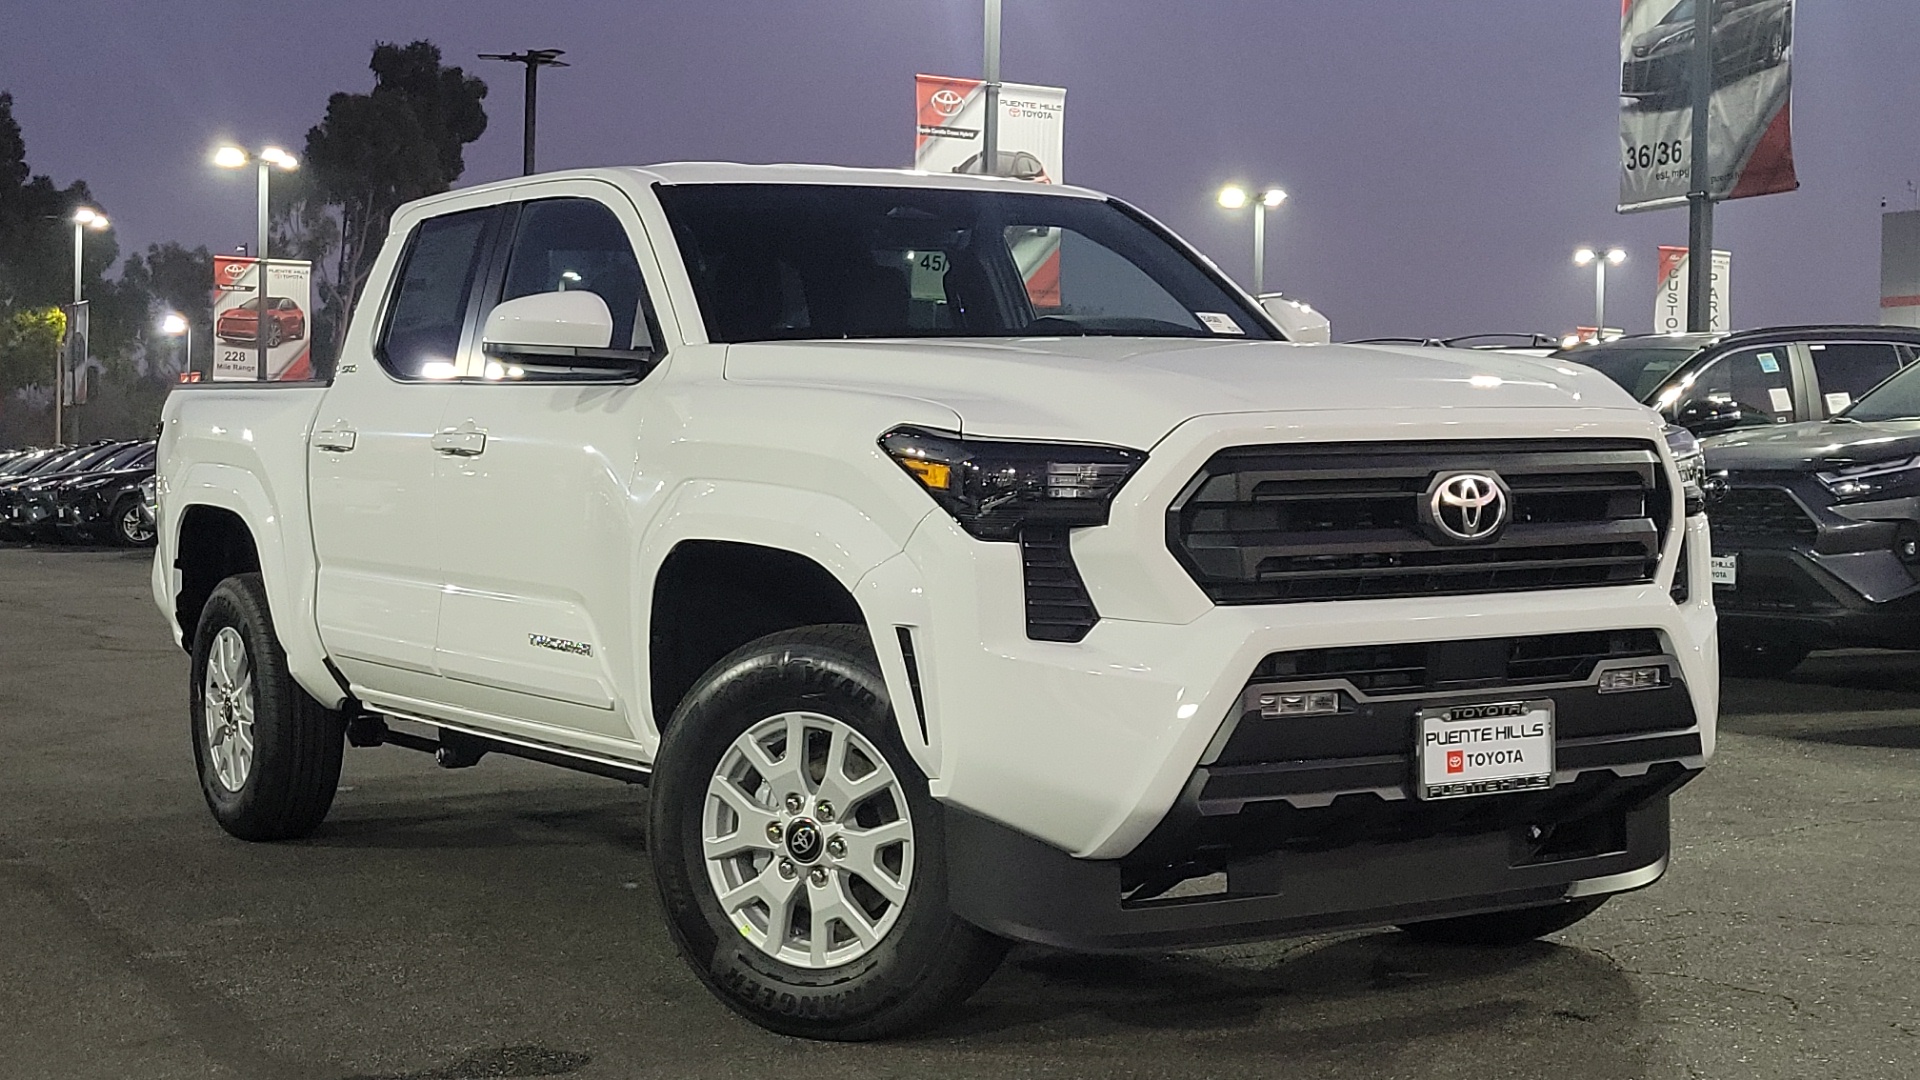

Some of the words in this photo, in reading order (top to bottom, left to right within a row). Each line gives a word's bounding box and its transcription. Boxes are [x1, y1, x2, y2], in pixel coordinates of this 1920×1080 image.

[1000, 99, 1037, 109] PUENTE
[1039, 103, 1062, 111] HILLS
[1022, 110, 1053, 119] TOYOTA
[1626, 140, 1682, 170] 36/36
[1665, 268, 1679, 333] CUSTO
[1709, 273, 1719, 332] PARK
[224, 351, 246, 362] 228
[217, 363, 231, 371] Mile
[233, 363, 255, 372] Range
[1452, 704, 1521, 719] TOYOTA
[1425, 727, 1493, 747] PUENTE
[1495, 723, 1544, 741] HILLS
[1466, 749, 1524, 768] TOYOTA
[1428, 781, 1498, 798] PUENTE
[1500, 776, 1549, 791] HILLS
